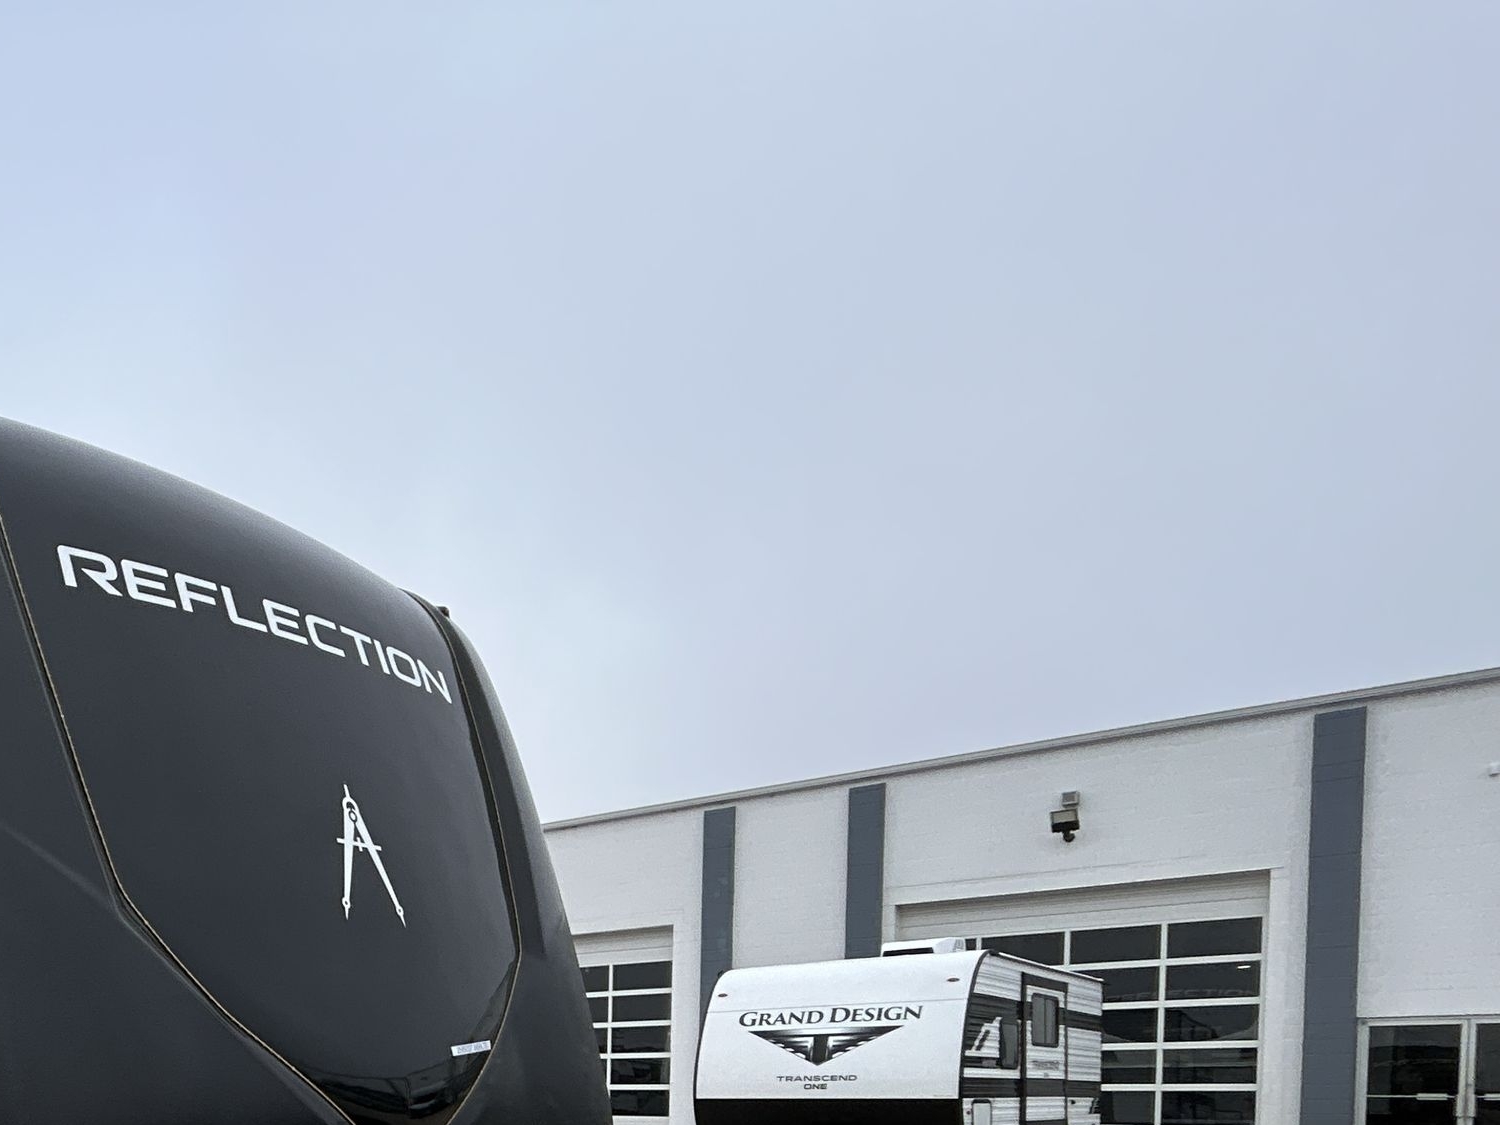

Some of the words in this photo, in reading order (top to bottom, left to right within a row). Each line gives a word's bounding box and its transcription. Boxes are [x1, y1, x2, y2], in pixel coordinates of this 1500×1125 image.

[56, 544, 453, 704] REFLECTION
[739, 1010, 824, 1027] GRAND
[829, 1005, 924, 1023] DESIGN
[776, 1074, 858, 1082] TRANSCEND
